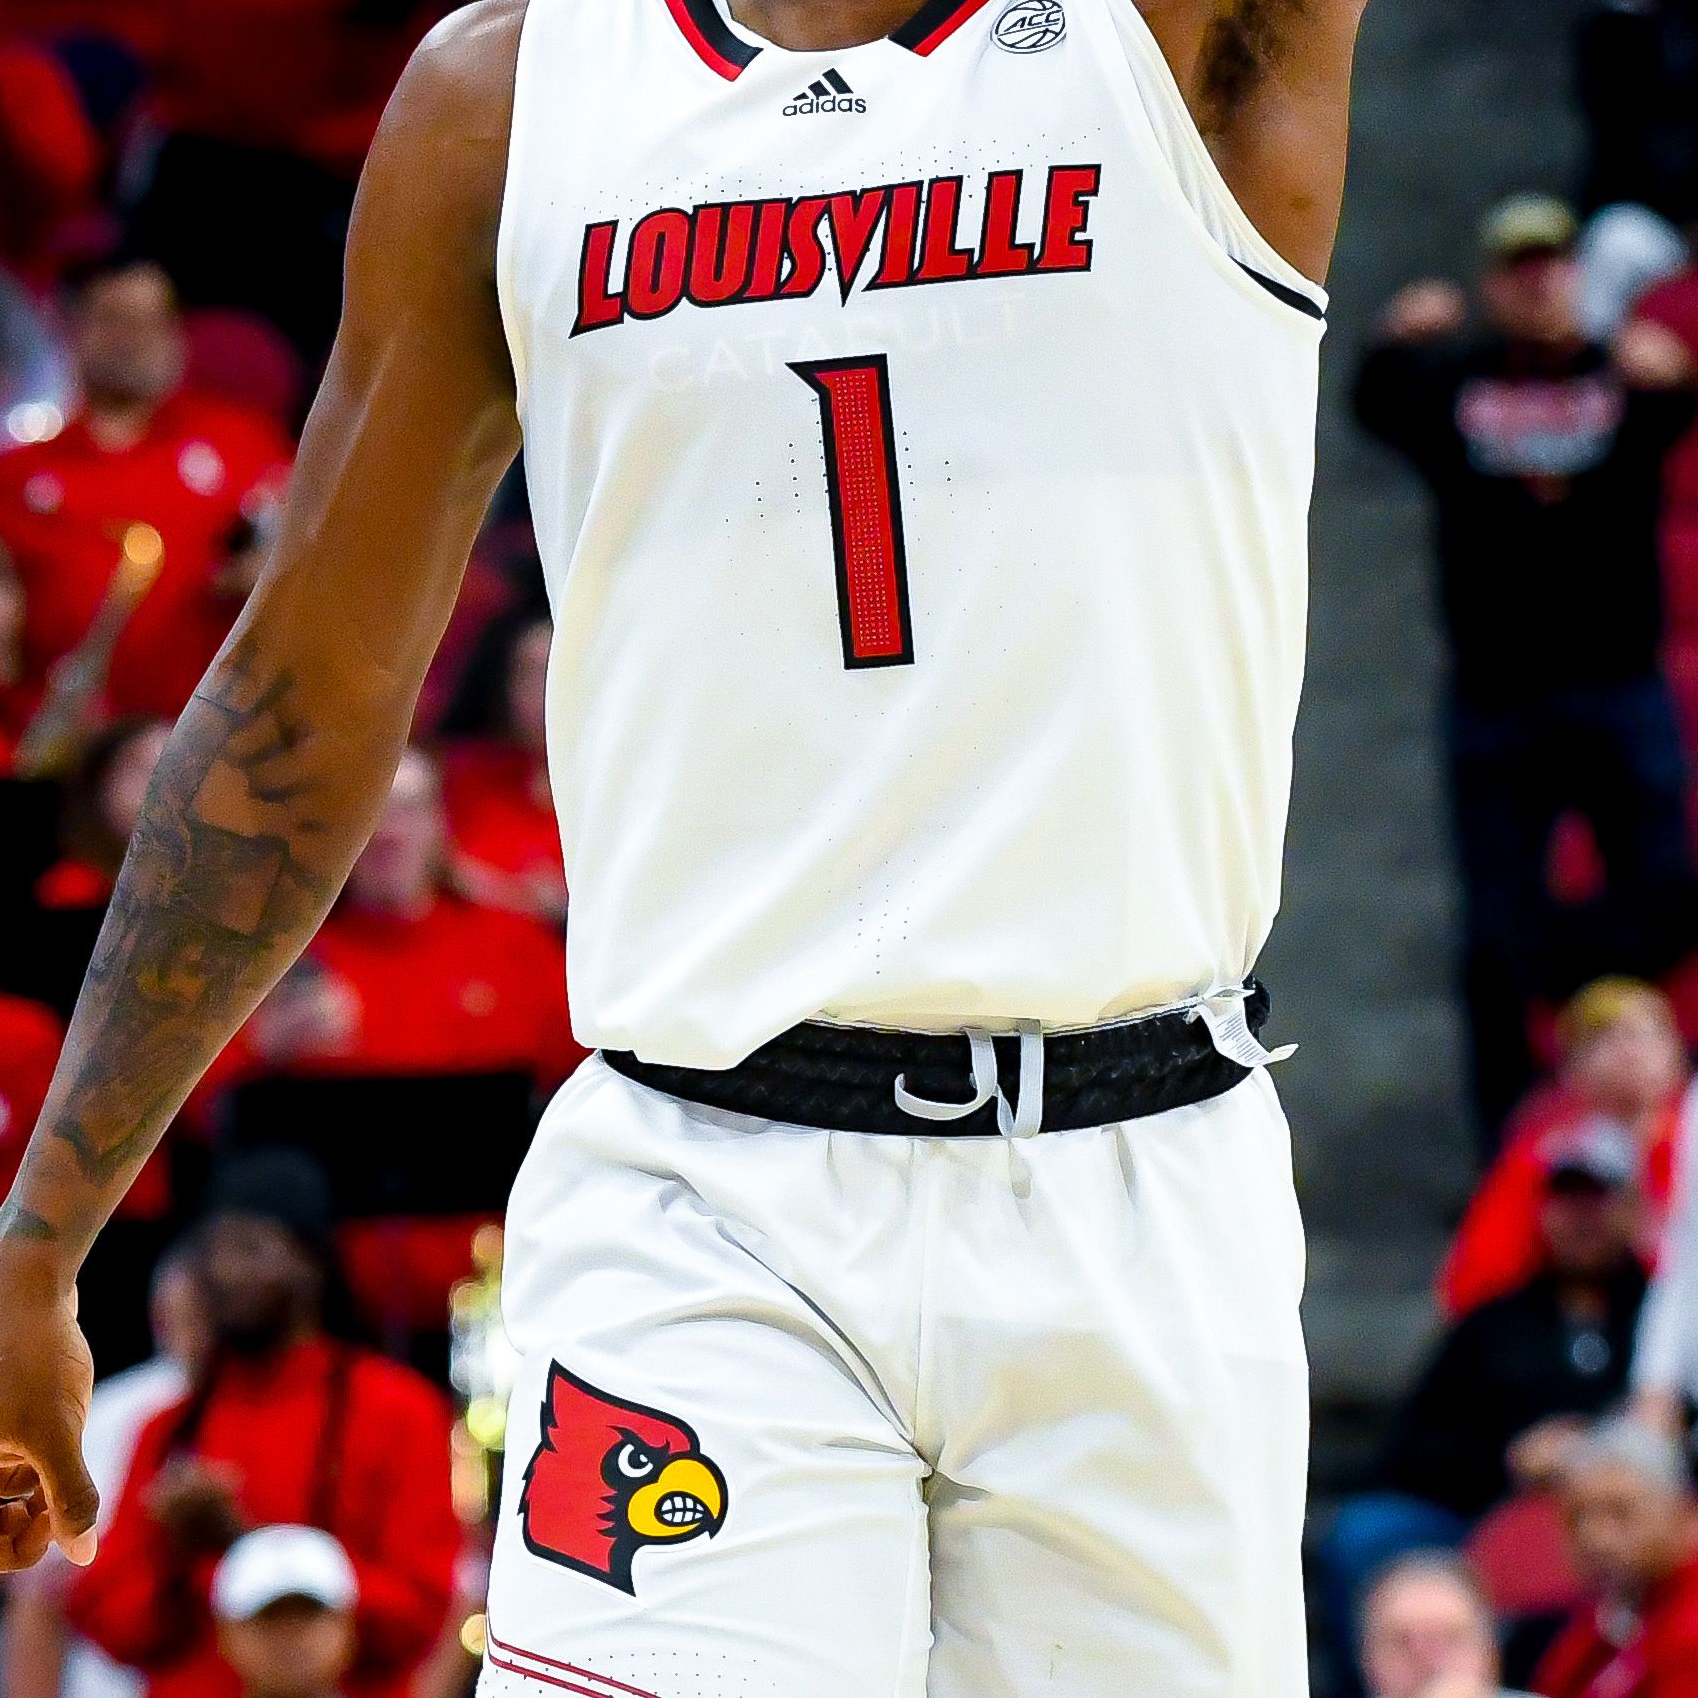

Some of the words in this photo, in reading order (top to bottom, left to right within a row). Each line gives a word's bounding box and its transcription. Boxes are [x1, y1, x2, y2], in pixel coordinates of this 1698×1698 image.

[1004, 10, 1062, 33] ACC
[782, 94, 867, 117] adidas
[568, 163, 1102, 339] LOUISVILLE
[784, 352, 916, 670] 1
